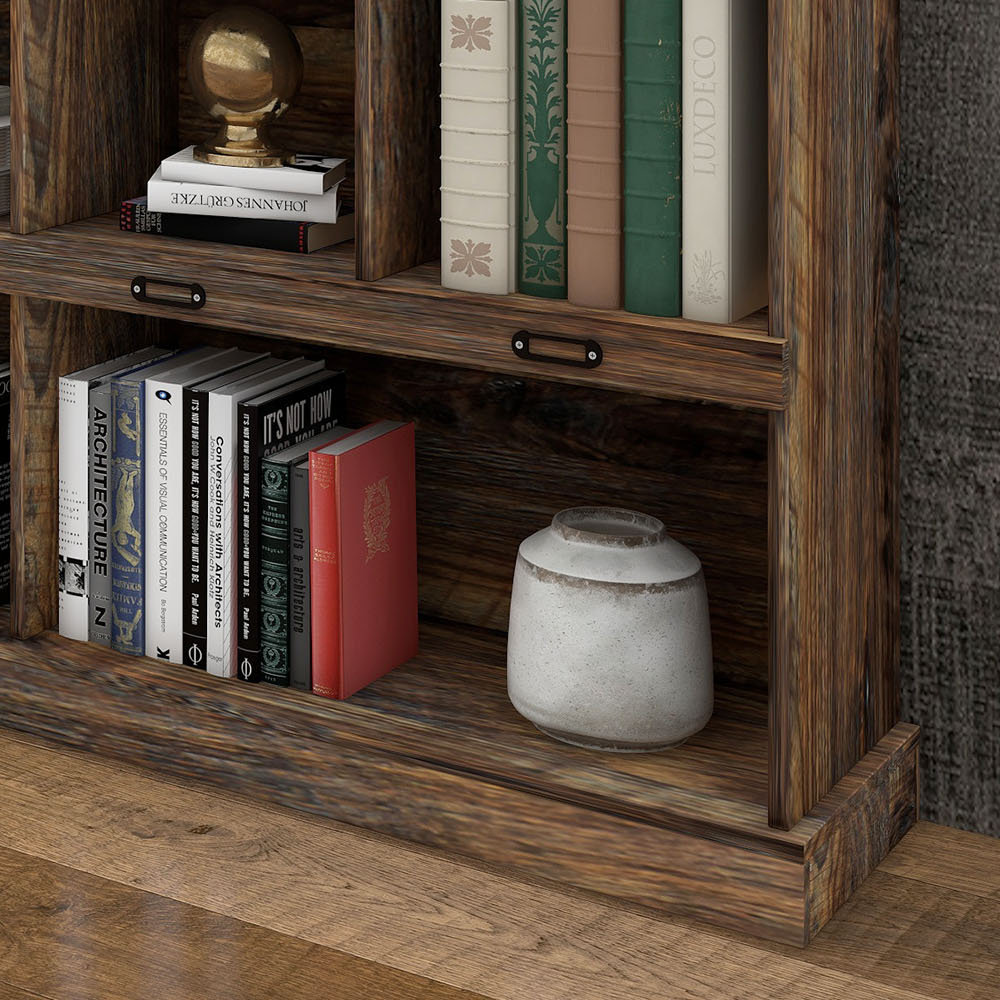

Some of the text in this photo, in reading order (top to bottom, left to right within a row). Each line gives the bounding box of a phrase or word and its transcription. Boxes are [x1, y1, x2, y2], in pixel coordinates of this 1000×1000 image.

[692, 34, 716, 177] LUXDECO
[236, 197, 308, 213] JOHANNES
[191, 399, 200, 411] IT'S
[191, 412, 200, 424] NOT
[242, 413, 250, 425] IT'S
[263, 408, 284, 446] IT'S
[286, 398, 307, 436] NOT
[310, 388, 333, 426] HOW
[191, 425, 200, 440] HOW
[242, 426, 250, 440] NOT
[191, 441, 200, 457] GOOD
[208, 435, 216, 461] John
[242, 440, 250, 455] HOW
[191, 458, 200, 470] YOU
[242, 455, 250, 471] GOOD
[242, 472, 250, 485] YOU
[93, 406, 108, 577] ARCHITECTURE
[191, 486, 200, 499] IT'S
[158, 412, 168, 593] ESSENTIALS OF VISUAL COMMUNICATION
[191, 499, 200, 515] HOW
[242, 501, 250, 513] IT'S
[242, 514, 250, 529] HOW
[214, 435, 224, 629] Conversations with Architects
[191, 546, 200, 564] WANT
[191, 564, 200, 573] TO
[242, 560, 250, 578] WANT
[242, 578, 250, 587] TO
[293, 527, 306, 633] arts architecture
[191, 592, 200, 607] Paul
[242, 607, 250, 621] Paul
